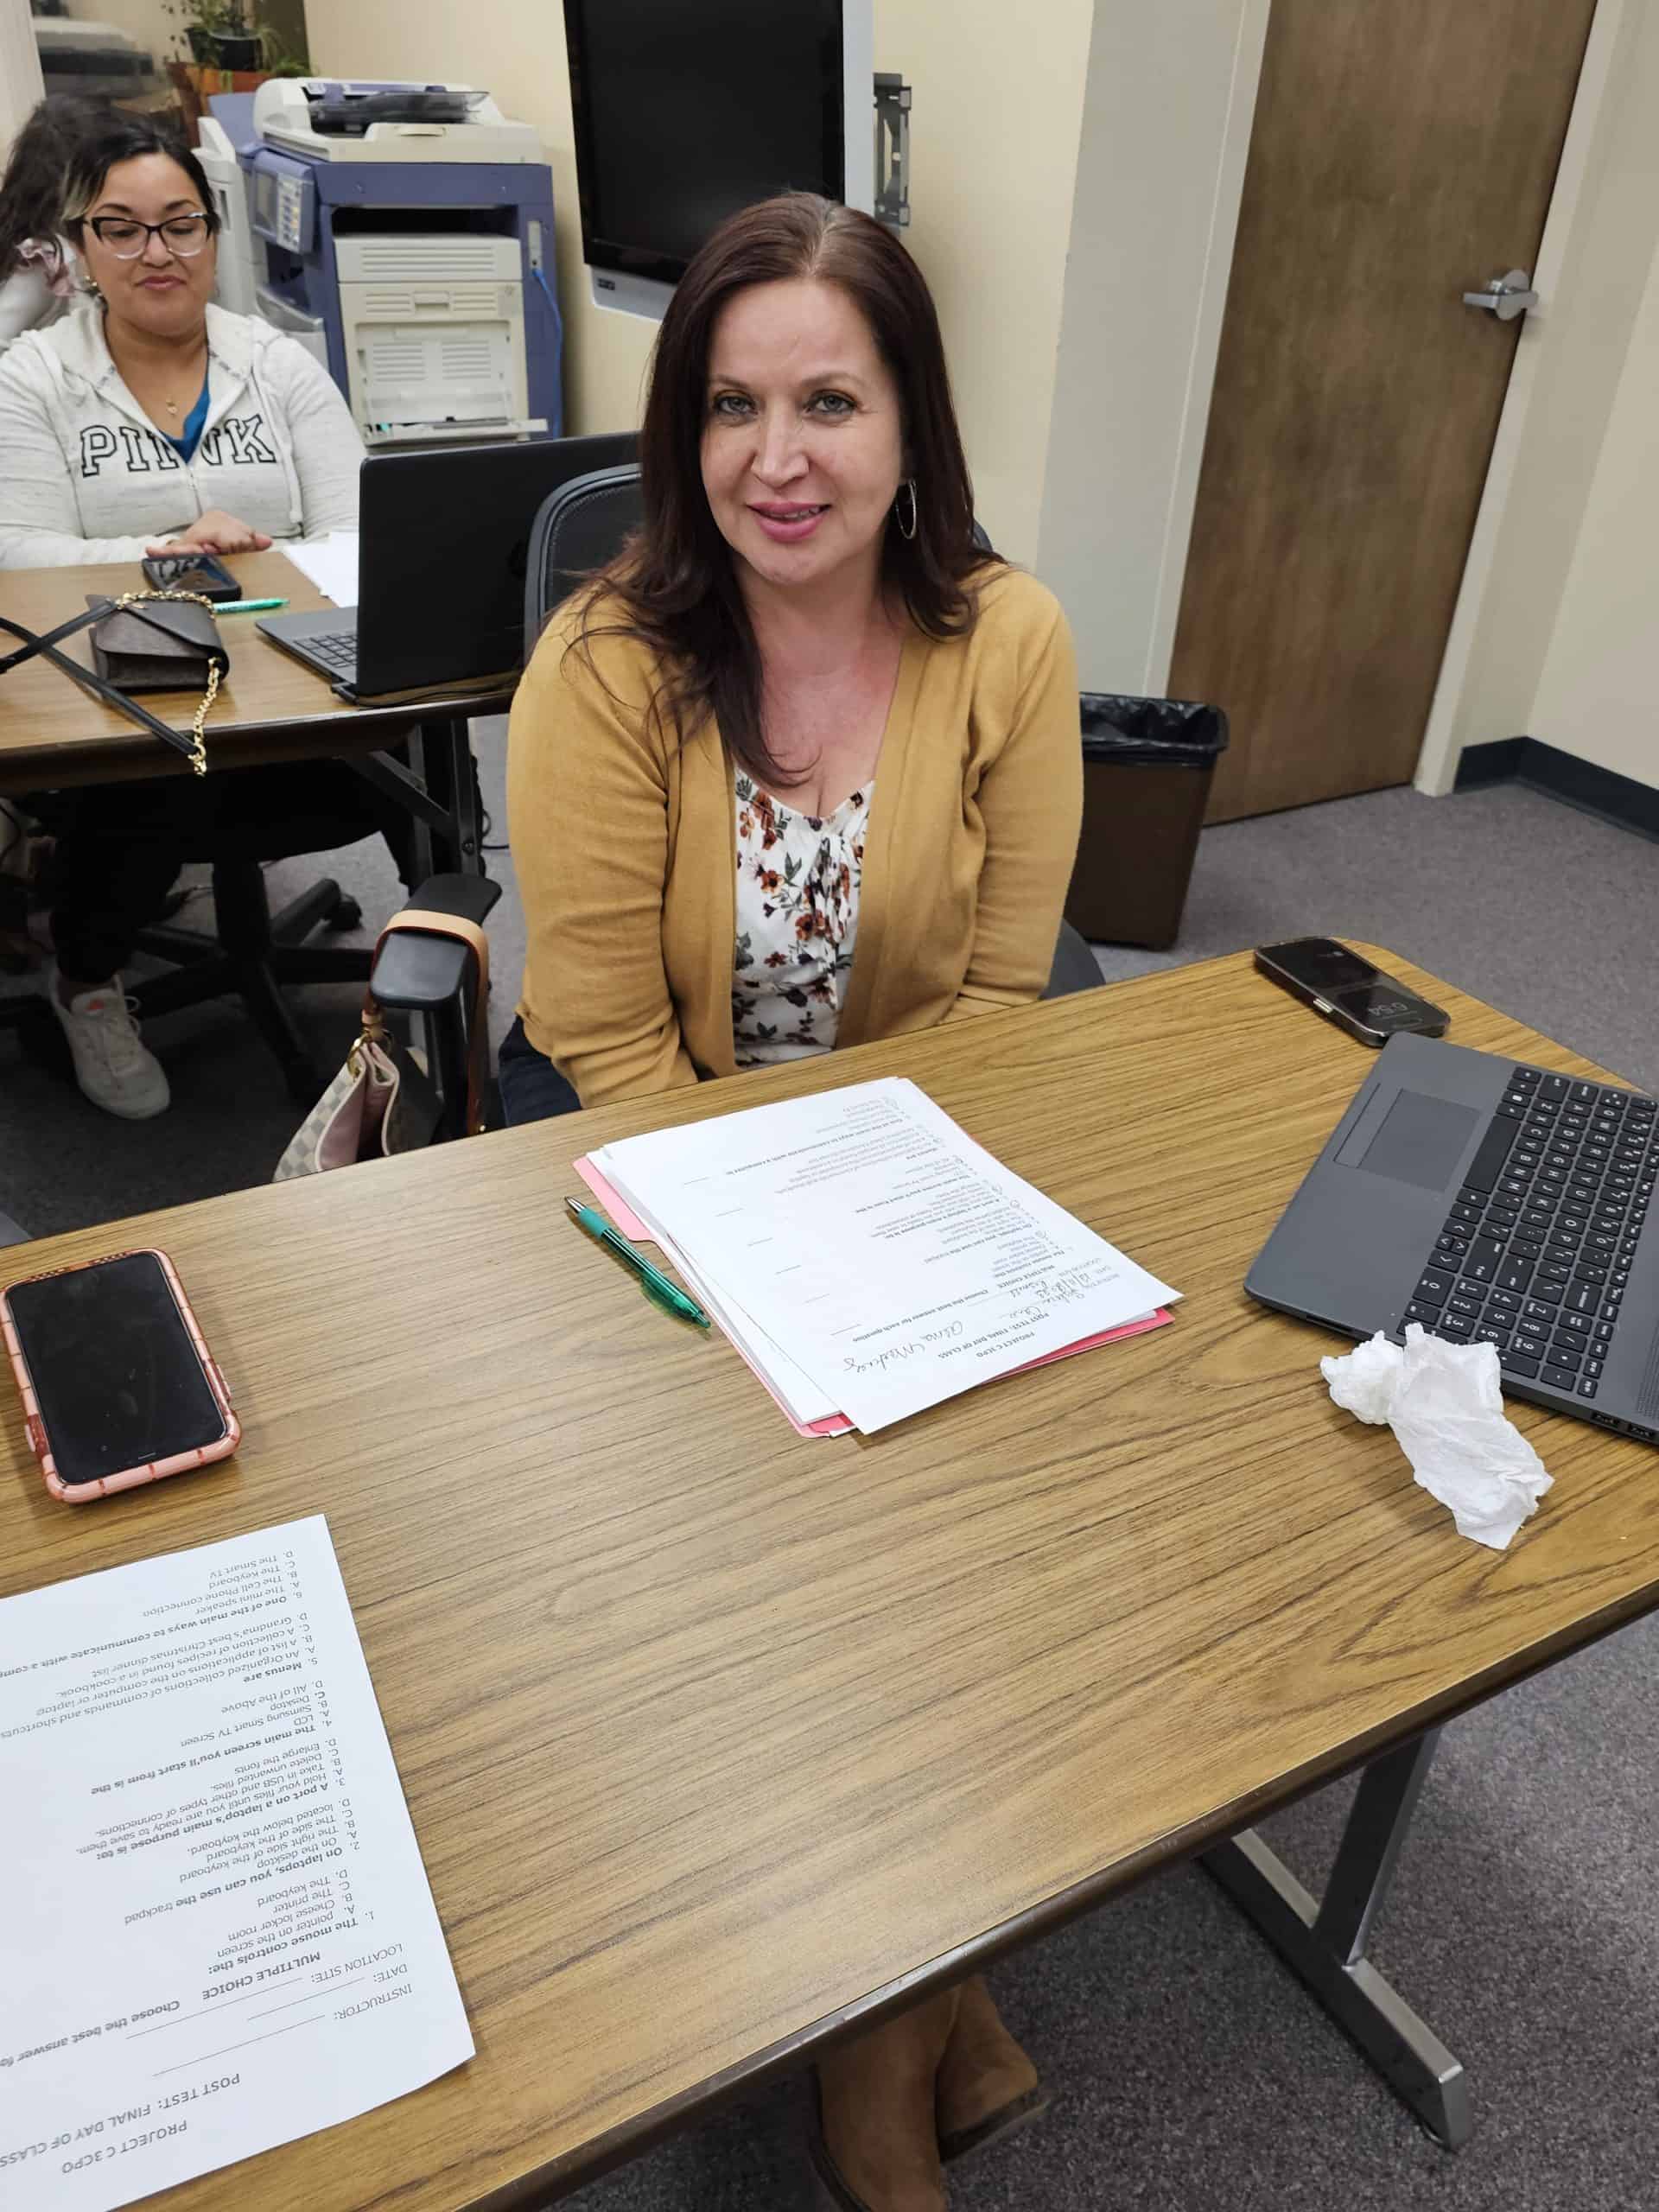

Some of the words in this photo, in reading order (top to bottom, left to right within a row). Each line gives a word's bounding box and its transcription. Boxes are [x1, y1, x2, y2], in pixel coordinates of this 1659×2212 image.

[81, 415, 276, 478] PINK
[264, 1662, 302, 1676] Menus
[243, 1672, 263, 1682] are
[280, 1689, 291, 1700] of
[292, 1683, 307, 1695] All
[258, 1693, 277, 1703] the
[270, 1694, 310, 1711] Desktop
[220, 1698, 257, 1713] Above
[266, 1701, 312, 1722] Samsung
[234, 1718, 264, 1732] Smart
[293, 1713, 314, 1726] LCD
[218, 1727, 232, 1738] TV
[295, 1725, 316, 1735] The
[181, 1732, 215, 1747] Screen
[264, 1731, 293, 1745] main
[224, 1739, 262, 1756] screen
[282, 1743, 321, 1759] Enlarge
[189, 1750, 221, 1767] you'll
[263, 1755, 280, 1765] the
[289, 1752, 322, 1768] Delete
[157, 1761, 187, 1776] start
[234, 1762, 261, 1775] fonts
[237, 1764, 287, 1786] unwanted
[287, 1771, 297, 1780] in
[299, 1763, 325, 1775] Take
[127, 1770, 156, 1784] from
[263, 1775, 284, 1788] USB
[91, 1784, 111, 1795] the
[113, 1780, 124, 1789] is
[241, 1782, 261, 1795] and
[320, 1783, 328, 1791] A
[211, 1789, 238, 1803] other
[292, 1784, 318, 1800] port
[179, 1797, 208, 1813] types
[265, 1800, 273, 1808] a
[276, 1795, 291, 1805] on
[165, 1808, 177, 1820] of
[215, 1803, 263, 1824] laptop's
[296, 1803, 334, 1823] located
[183, 1819, 213, 1834] main
[263, 1816, 294, 1832] below
[291, 1821, 313, 1834] side
[315, 1815, 337, 1826] The
[243, 1827, 260, 1839] the
[278, 1830, 289, 1840] of
[318, 1825, 340, 1837] The
[130, 1827, 180, 1850] purpose
[258, 1834, 276, 1845] the
[291, 1833, 315, 1847] right
[321, 1837, 337, 1847] On
[117, 1846, 127, 1854] is
[207, 1840, 256, 1864] keyboard
[266, 1841, 289, 1853] side
[301, 1843, 319, 1854] the
[326, 1847, 343, 1858] On
[232, 1853, 251, 1865] the
[253, 1849, 264, 1860] of
[255, 1846, 298, 1869] desktop
[179, 1860, 230, 1884] keyboard
[249, 1868, 272, 1884] you
[225, 1878, 247, 1891] can
[308, 1876, 331, 1888] The
[200, 1886, 222, 1899] use
[257, 1884, 308, 1908] keyboard
[311, 1887, 334, 1900] The
[175, 1895, 197, 1907] the
[273, 1891, 309, 1914] printer
[124, 1903, 174, 1925] trackpad
[296, 1899, 335, 1918] Cheese
[260, 1914, 294, 1931] locker
[296, 1910, 334, 1931] pointer
[334, 1917, 359, 1930] The
[227, 1925, 257, 1942] room
[257, 1932, 276, 1945] the
[278, 1926, 293, 1937] on
[291, 1926, 333, 1946] mouse
[217, 1939, 254, 1958] screen
[237, 1942, 289, 1964] controls
[345, 1943, 403, 1973] LOCATION
[208, 1960, 234, 1974] the:
[256, 1951, 321, 1981] MULTIPLE
[372, 1963, 408, 1983] DATE:
[310, 1965, 342, 1984] SITE:
[201, 1975, 253, 2000] CHOICE
[334, 1983, 412, 2019] INSTRUCTOR:
[130, 2000, 181, 2023] Choose
[105, 2018, 128, 2031] the
[71, 2026, 102, 2044] best
[16, 2037, 68, 2062] answer
[202, 2073, 240, 2096] POST
[157, 2088, 200, 2109] TEST:
[107, 2104, 151, 2127] FINAL
[75, 2120, 105, 2140] DAY
[120, 2120, 188, 2154] PROJECT
[51, 2133, 72, 2150] OF
[0, 2142, 48, 2167] CLASS
[106, 2146, 116, 2158] C
[61, 2150, 103, 2174] 3CPO
